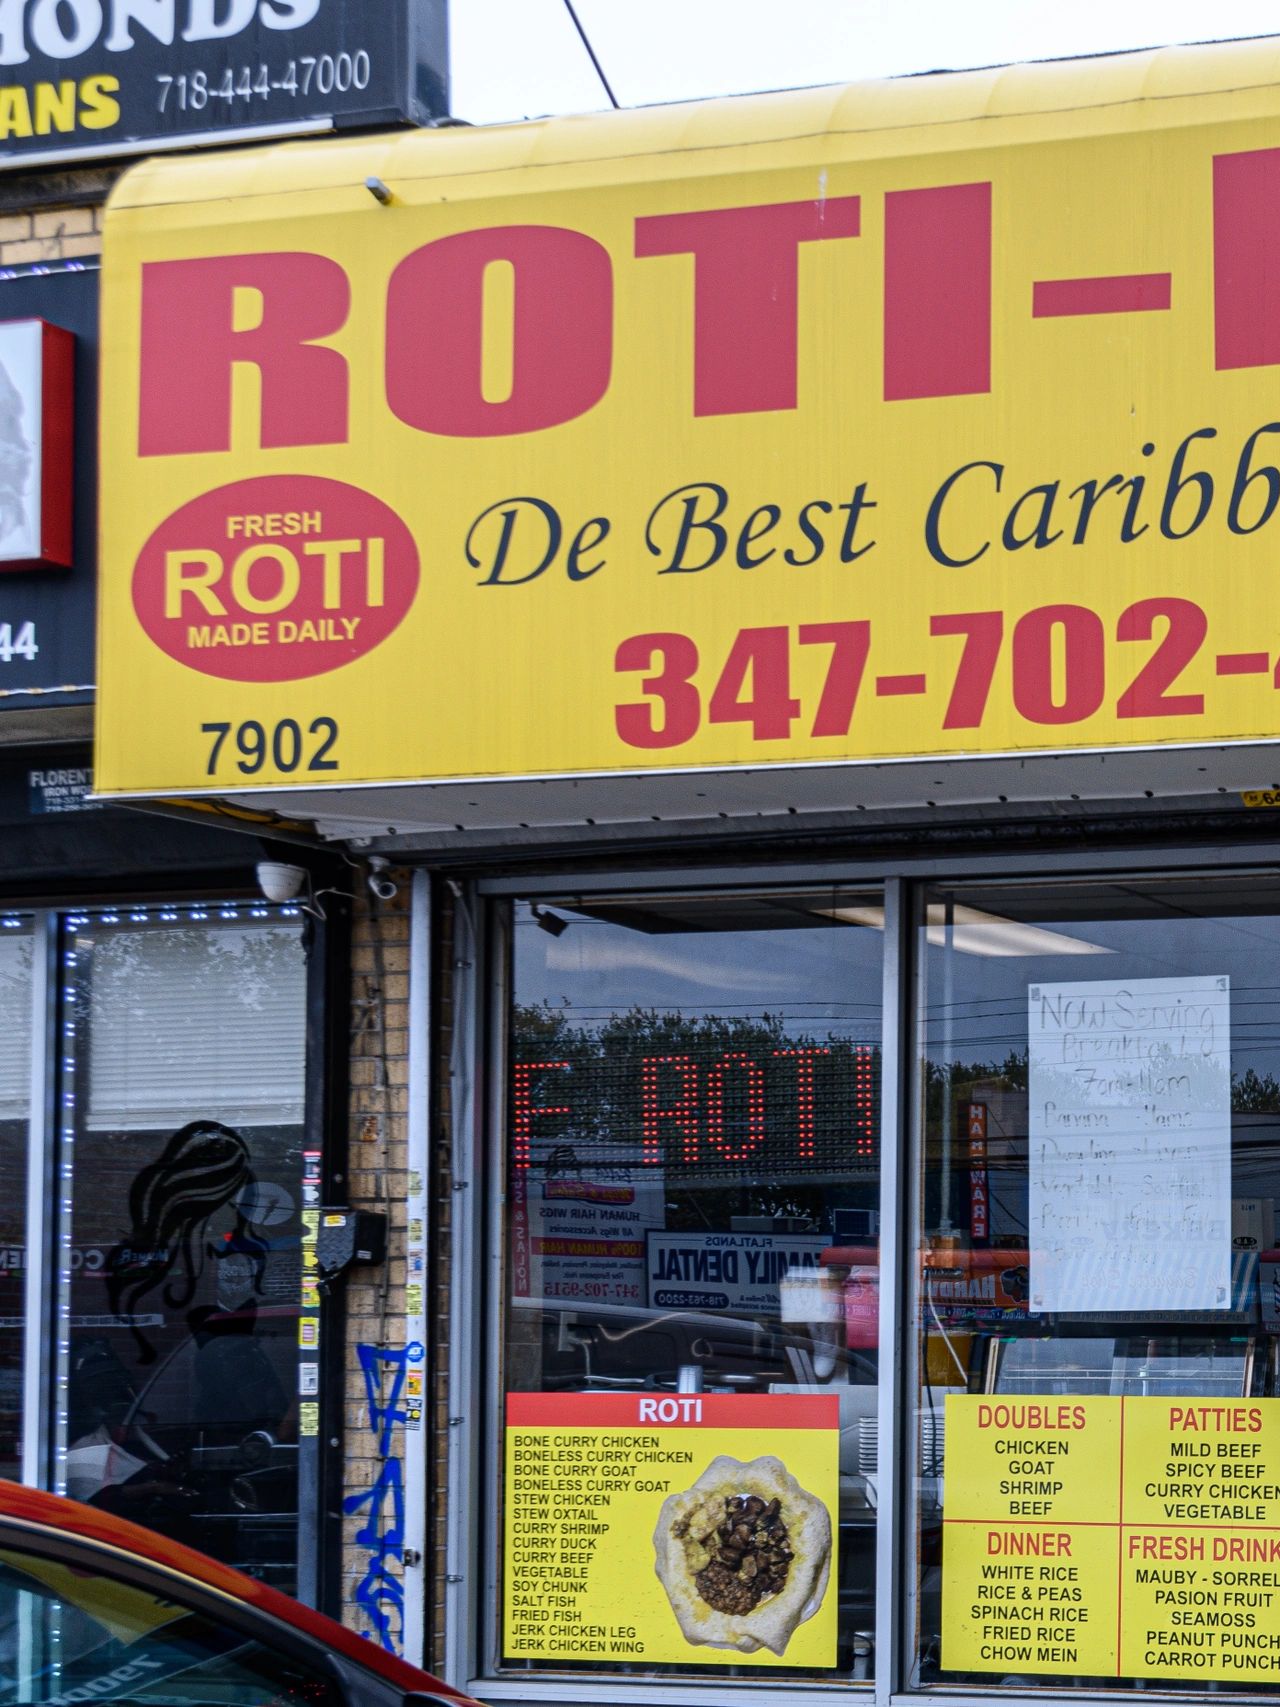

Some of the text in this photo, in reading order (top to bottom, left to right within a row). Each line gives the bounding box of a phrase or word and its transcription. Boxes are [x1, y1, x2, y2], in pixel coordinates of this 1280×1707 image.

[155, 49, 370, 113] 718-444-47000
[0, 75, 120, 139] ANS
[227, 511, 322, 539] FRESH
[465, 497, 611, 586] De
[645, 482, 877, 575] Best
[164, 537, 385, 619] ROTI
[187, 617, 361, 648] MADE DAILY
[201, 717, 339, 775] 7902
[640, 1399, 702, 1422] ROTI
[978, 1405, 1085, 1429] DOUBLES
[1170, 1408, 1262, 1432] PATTIES
[514, 1436, 659, 1448] BONE CURRY CHICKEN
[995, 1440, 1068, 1454] CHICKEN
[514, 1450, 692, 1462] BONELESS CURRY CHICKEN
[1171, 1443, 1261, 1458] MILD BEEF
[1009, 1461, 1054, 1474] GOAT
[1166, 1463, 1265, 1478] SPICY BEEF
[1000, 1481, 1062, 1495] SHRIMP
[1146, 1483, 1204, 1498] CURRY
[514, 1494, 610, 1506] STEW CHICKEN
[514, 1508, 598, 1520] STEW OXTAIL
[1010, 1501, 1052, 1515] BEEF
[1164, 1504, 1266, 1520] VEGETABLE
[513, 1522, 609, 1534] CURRY SHRIMP
[988, 1532, 1072, 1556] DINNER
[1130, 1536, 1204, 1560] FRESH
[512, 1566, 588, 1578] VEGETABLE
[982, 1566, 1078, 1581] WHITE RICE
[1136, 1570, 1196, 1584] MAUBY
[513, 1580, 587, 1592] SOY CHUNK
[978, 1586, 1082, 1601] RICE & PEAS
[512, 1595, 576, 1607] SALT FISH
[1156, 1590, 1273, 1607] PASION FRUIT
[972, 1605, 1088, 1622] SPINACH RICE
[1172, 1612, 1255, 1628] SEAMOSS
[512, 1624, 636, 1638] JERK CHICKEN LEG
[984, 1626, 1075, 1642] FRIED RICE
[512, 1639, 644, 1653] JERK CHICKEN WING
[1147, 1631, 1280, 1649] PEANUT PUNCH
[981, 1646, 1077, 1662] CHOW MEIN
[1145, 1651, 1280, 1670] CARROT PUNCH
